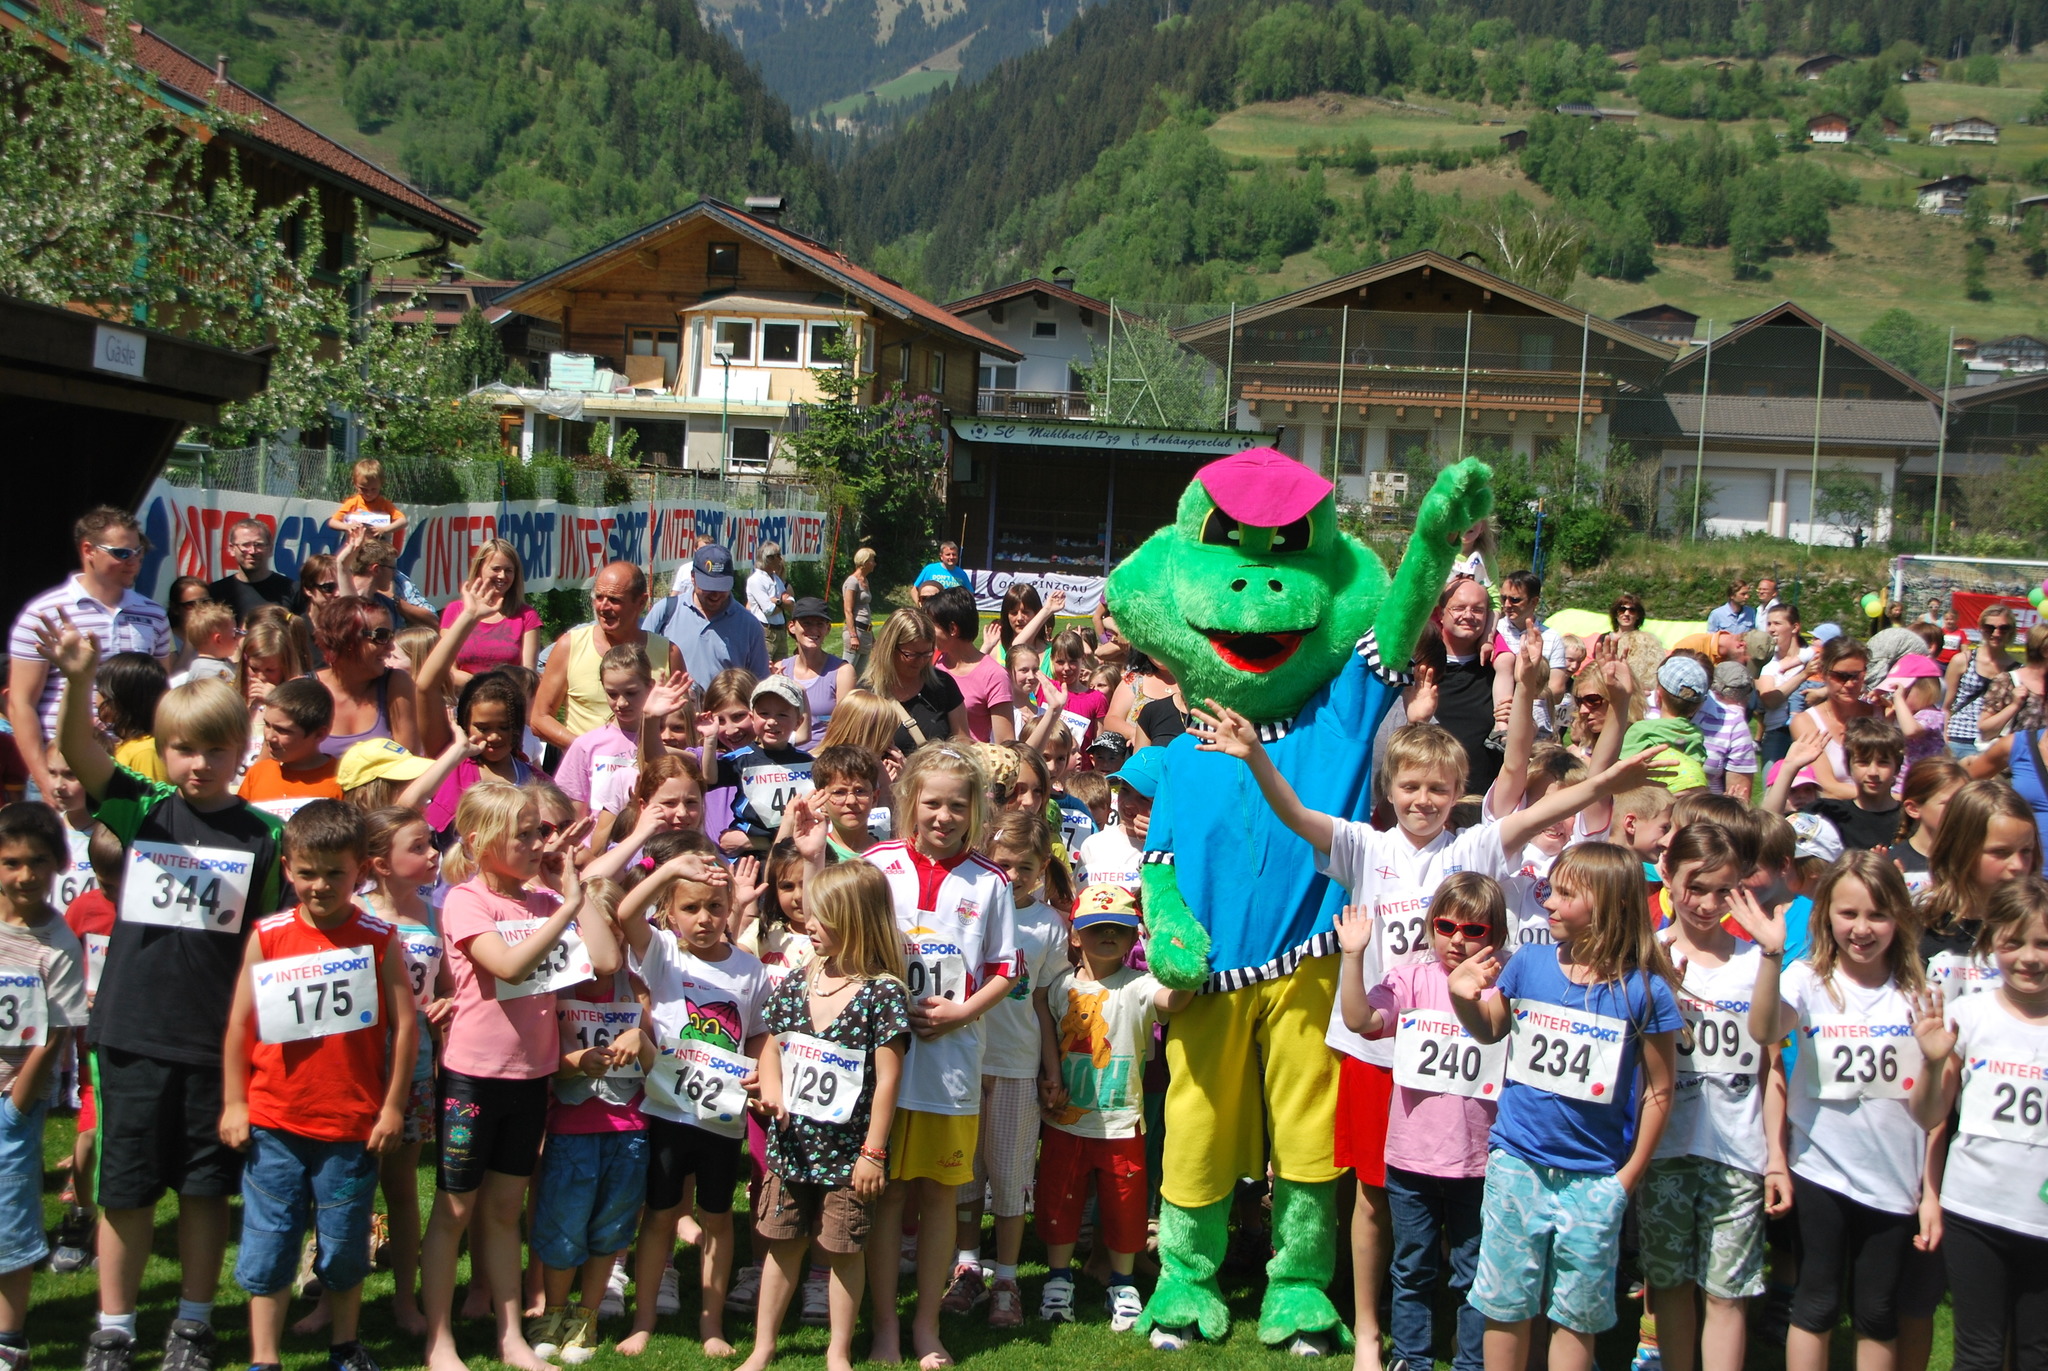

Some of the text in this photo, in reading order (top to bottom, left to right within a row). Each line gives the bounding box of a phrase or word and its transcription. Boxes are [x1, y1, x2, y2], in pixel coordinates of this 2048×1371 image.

[105, 335, 136, 367] Gäste
[993, 425, 1016, 439] SC
[1144, 433, 1233, 449] Anhängerclub
[736, 515, 787, 561] INTERPORT
[791, 515, 825, 555] INTERS
[998, 580, 1088, 593] OPINZGAU
[755, 770, 812, 784] INTERSPOR
[1063, 814, 1089, 824] SPORT
[1060, 827, 1076, 852] 7
[152, 852, 248, 875] INTERSPORT
[1090, 871, 1140, 882] INTERSP
[152, 872, 221, 915] 344
[1378, 895, 1434, 917] INTERS
[1387, 916, 1430, 956] 32
[0, 975, 41, 988] SPORT
[275, 957, 370, 983] INTERSPORT
[907, 961, 942, 997] 01
[1951, 966, 2001, 981] INTERSP
[287, 978, 354, 1025] 175
[567, 1009, 637, 1024] INTERSPORT
[1417, 1019, 1472, 1038] INTERS
[1529, 1011, 1620, 1043] INTERSPORT
[576, 1026, 625, 1049] 16
[1822, 1025, 1915, 1038] INTERSPORT
[674, 1048, 750, 1079] INTERSPORT
[790, 1041, 860, 1072] INTERSPORT
[1416, 1038, 1482, 1083] 240
[1528, 1033, 1592, 1084] 234
[1832, 1044, 1898, 1083] 236
[1987, 1059, 2048, 1081] INTERS
[673, 1065, 724, 1112] 162
[789, 1062, 838, 1107] 129
[1992, 1081, 2048, 1127] 26
